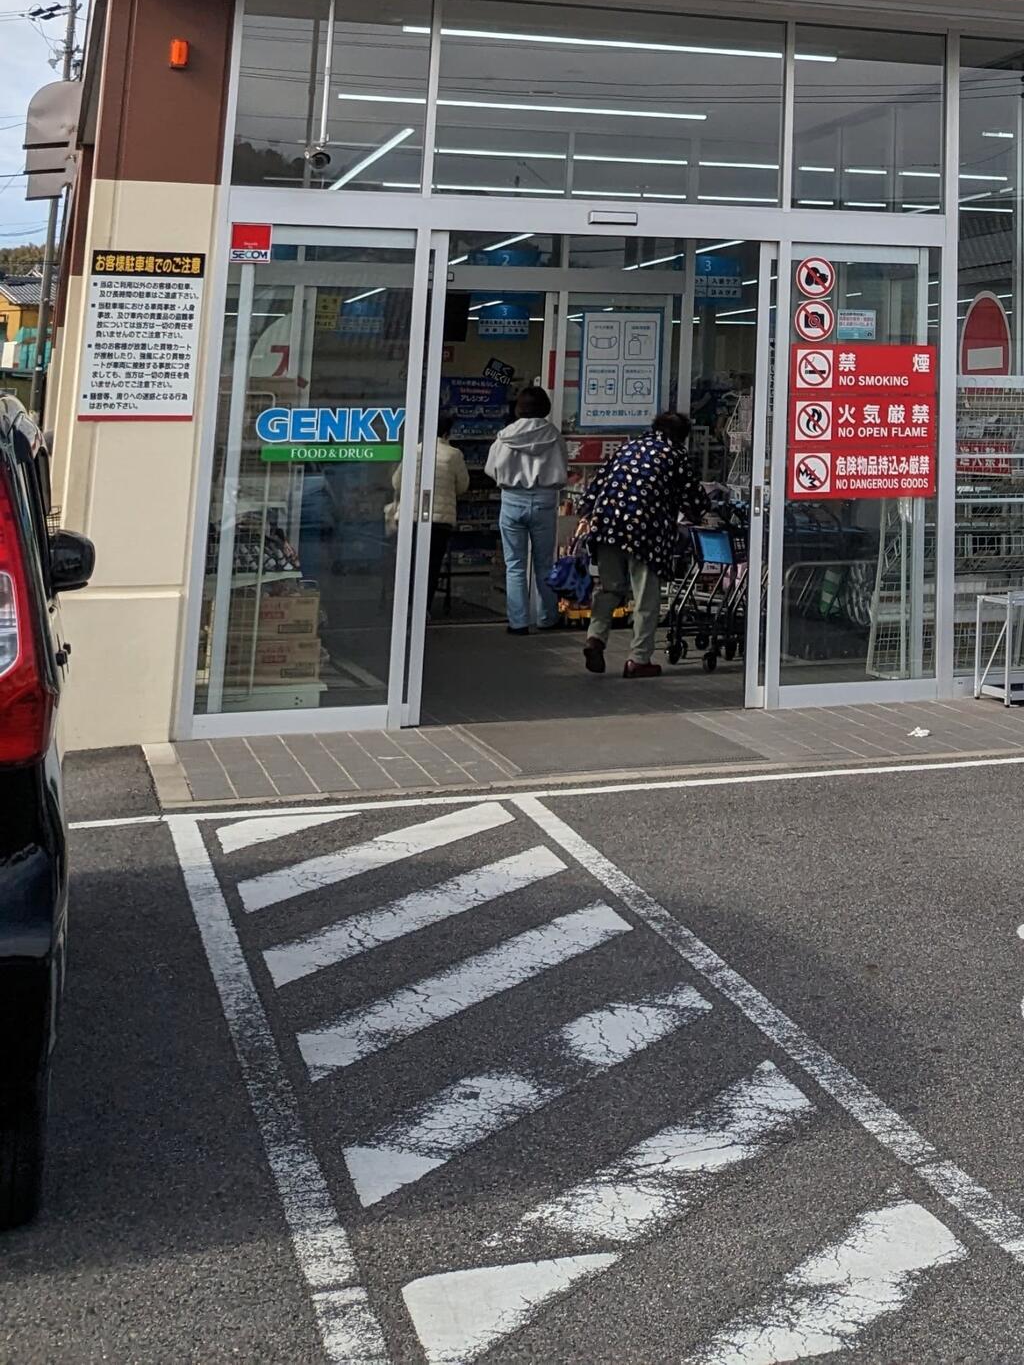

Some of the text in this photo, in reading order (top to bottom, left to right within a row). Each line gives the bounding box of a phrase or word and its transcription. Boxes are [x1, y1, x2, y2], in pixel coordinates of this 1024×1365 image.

[232, 250, 268, 259] SECOM
[95, 254, 201, 274] お客様駐車場でのご注意
[838, 375, 909, 386] NO SMOKING
[838, 404, 930, 424] 火気厳禁
[256, 408, 406, 442] GENKY
[838, 427, 928, 437] NO OPEN FLAME
[836, 455, 930, 475] 危険物品持込み厳禁
[836, 478, 928, 489] NO DANGEROUS GOODS
